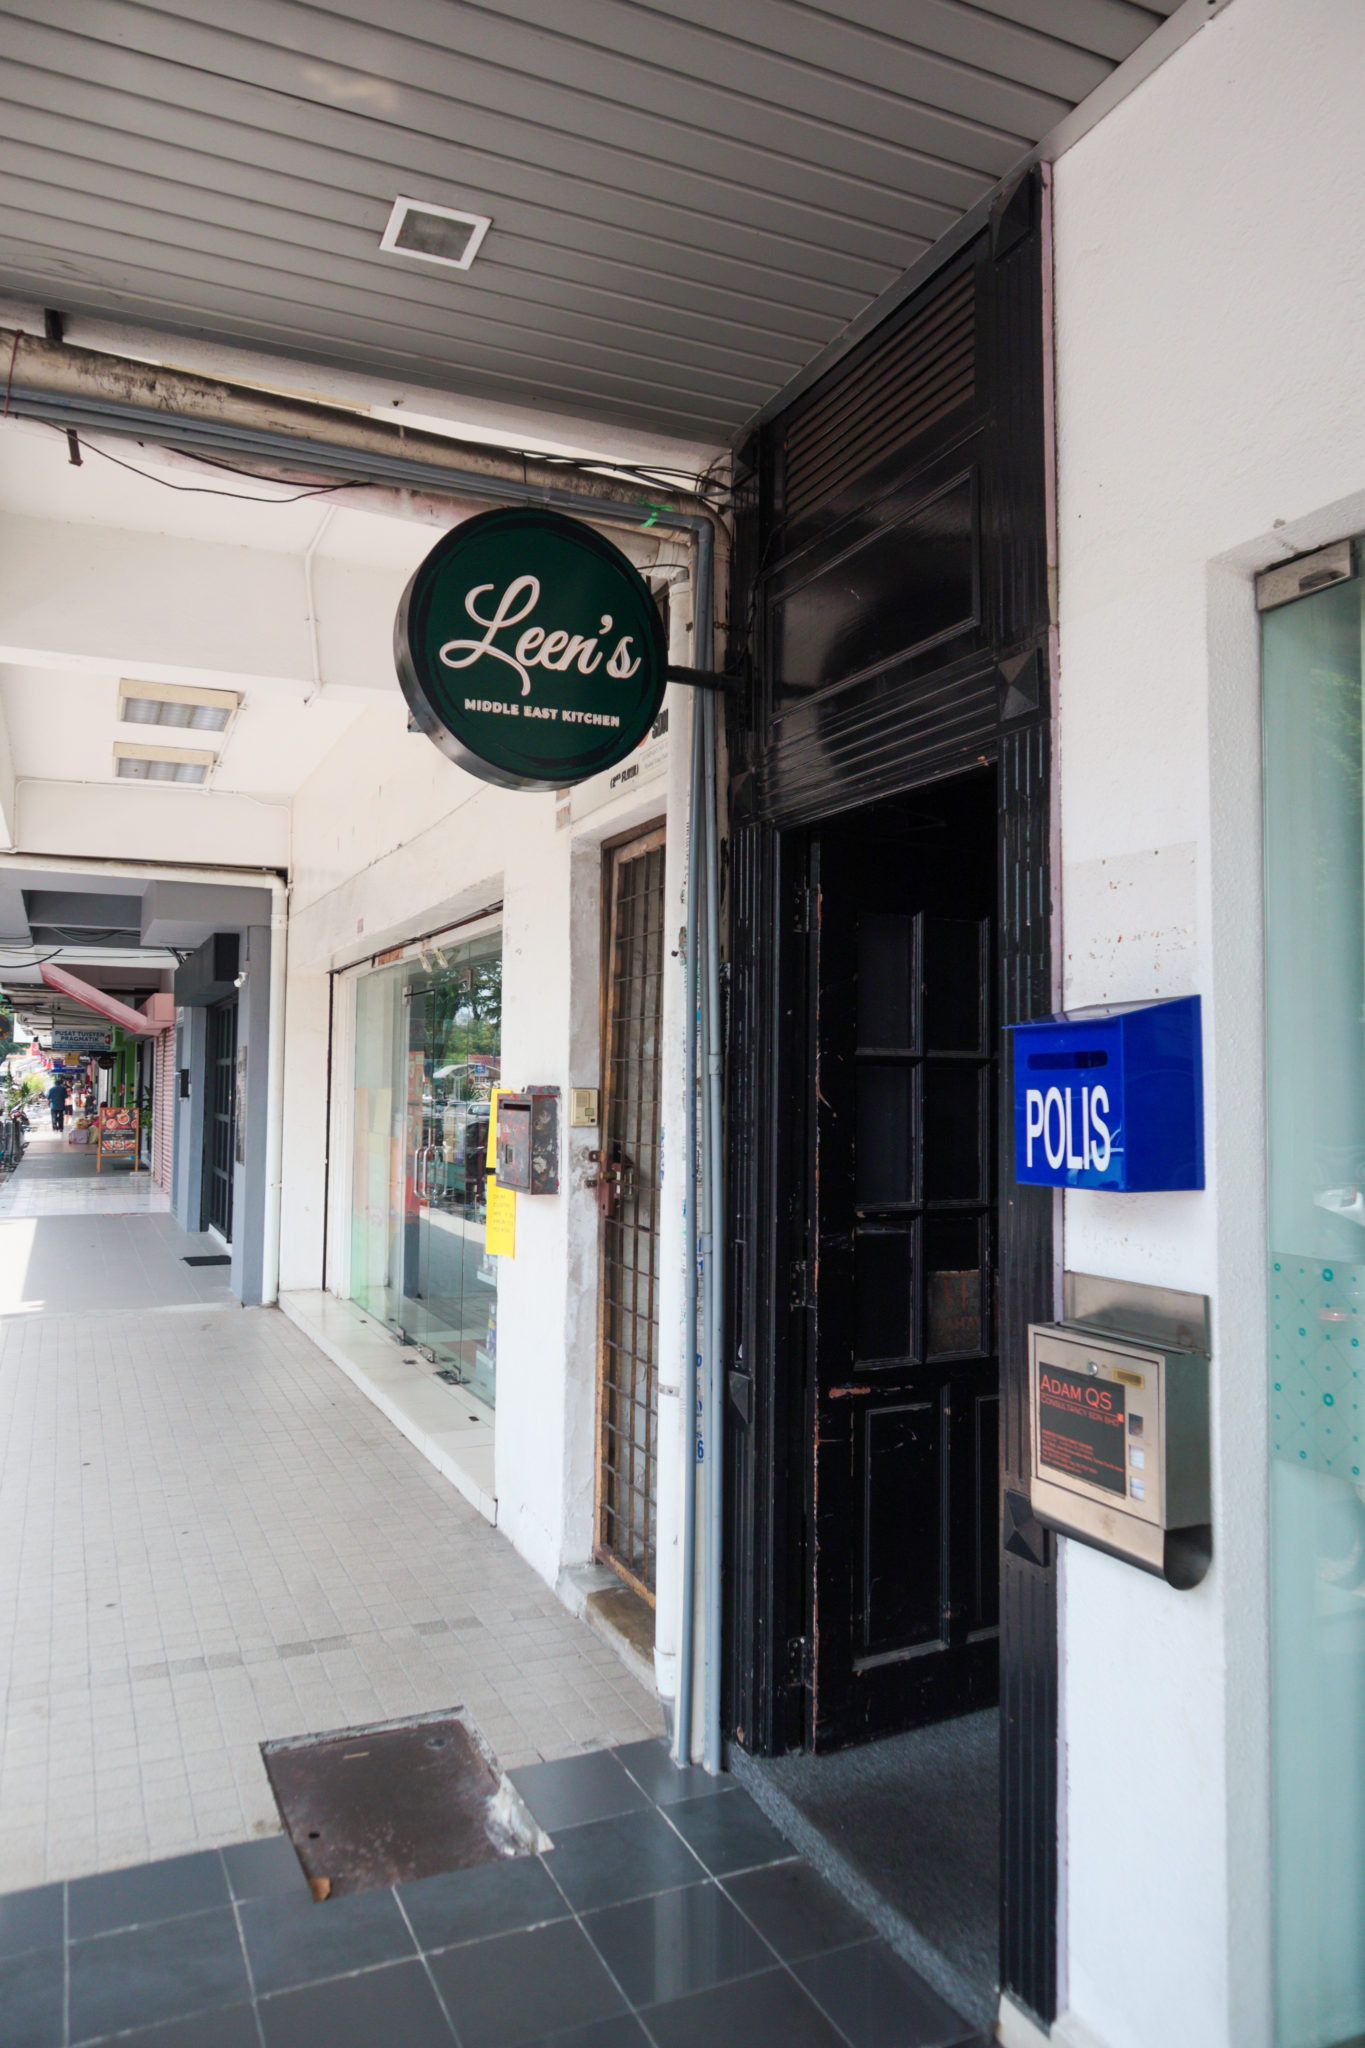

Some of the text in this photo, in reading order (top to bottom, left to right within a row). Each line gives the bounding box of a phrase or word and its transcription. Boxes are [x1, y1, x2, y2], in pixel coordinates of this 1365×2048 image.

[439, 575, 642, 696] Leen's
[464, 698, 620, 727] MIDDLE EAST KITCHEN
[1026, 1085, 1111, 1172] POLIS
[1040, 1374, 1113, 1411] ADAM QS
